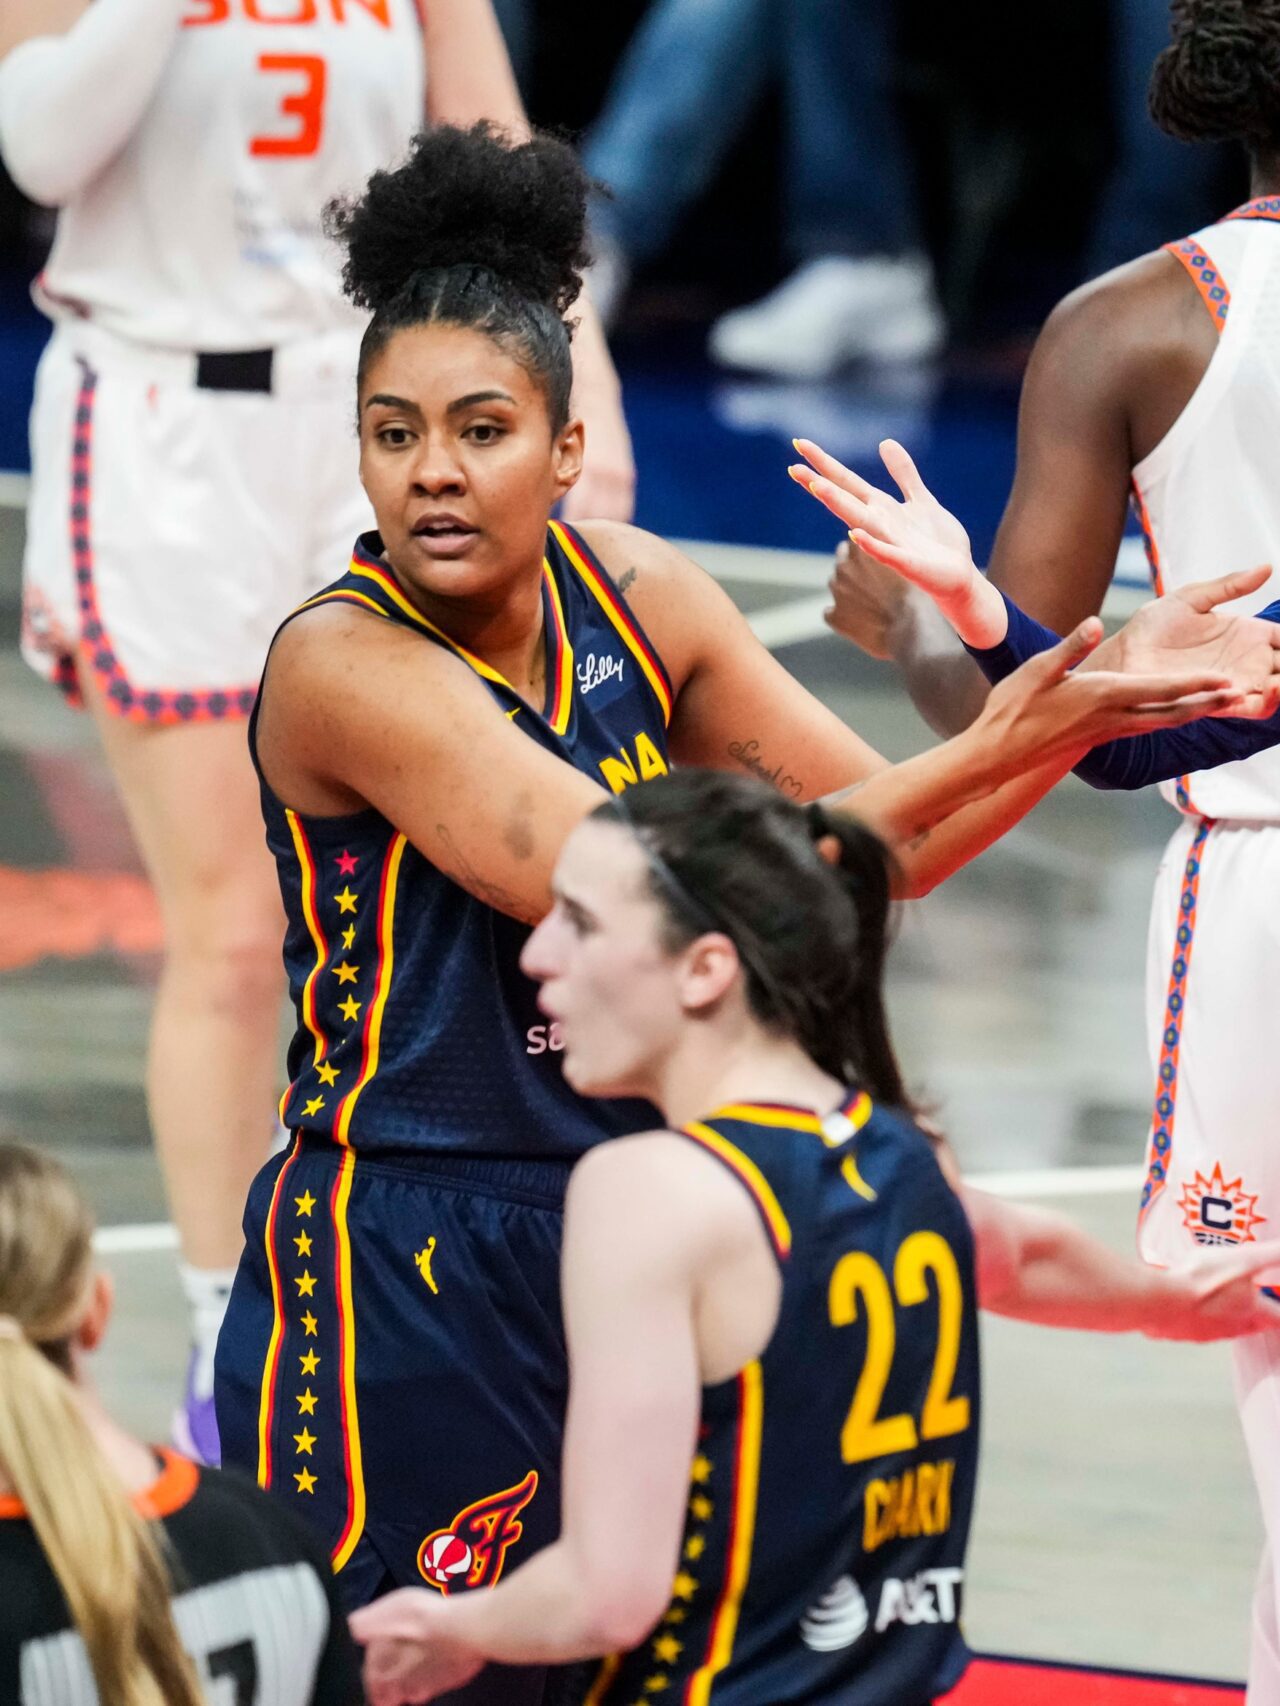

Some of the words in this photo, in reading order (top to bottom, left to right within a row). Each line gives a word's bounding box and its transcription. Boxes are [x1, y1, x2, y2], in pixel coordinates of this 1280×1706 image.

[250, 53, 326, 157] 3
[577, 653, 624, 694] Lilly
[828, 1231, 970, 1464] 22
